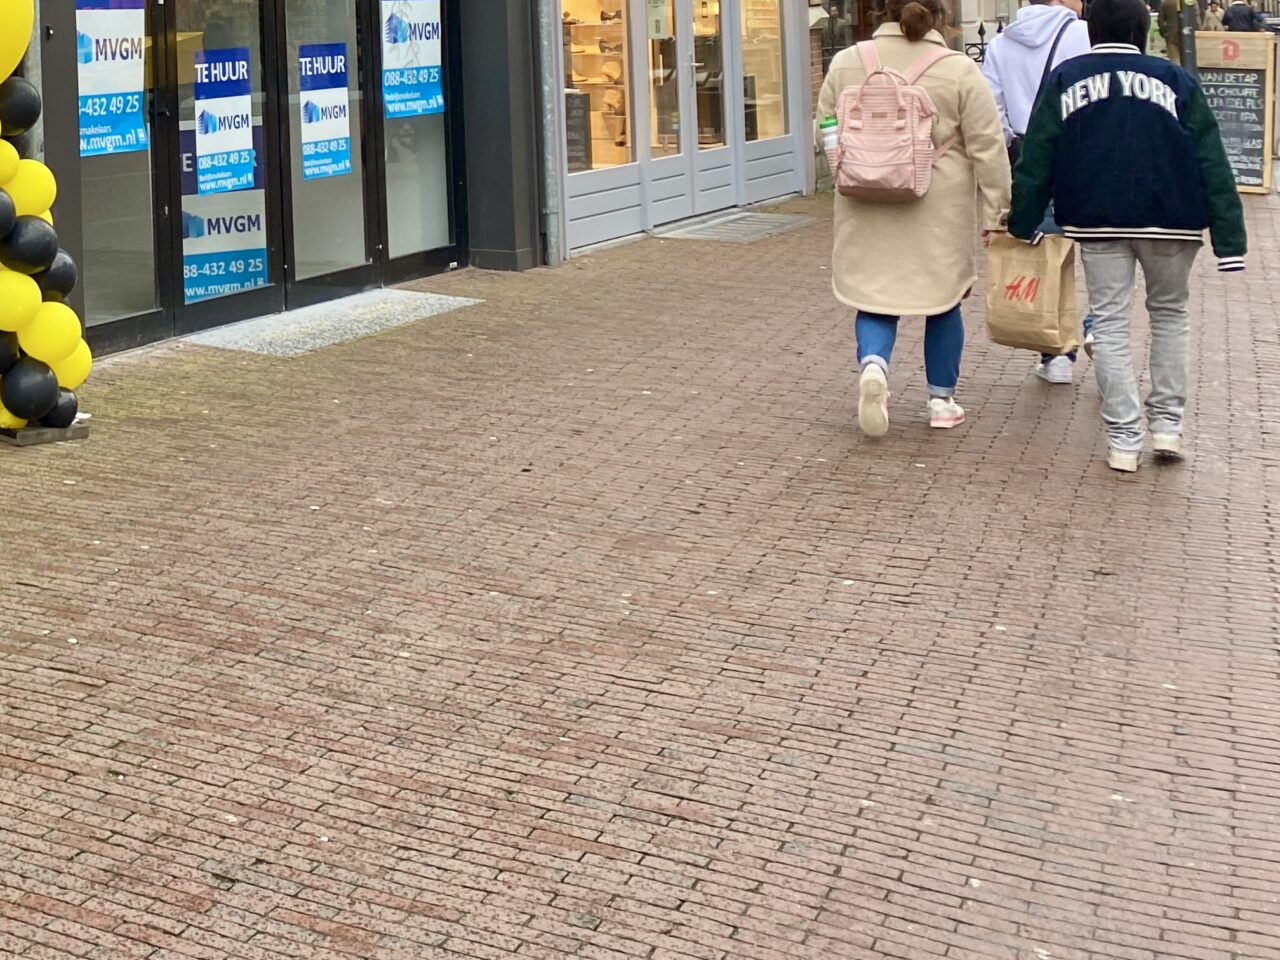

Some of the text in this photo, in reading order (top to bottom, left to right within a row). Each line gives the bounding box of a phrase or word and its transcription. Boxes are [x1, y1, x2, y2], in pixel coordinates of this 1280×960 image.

[409, 22, 440, 41] MVGM
[95, 38, 142, 61] MVGM
[194, 60, 248, 83] TE HUUR
[299, 55, 346, 76] TE HUUR
[418, 69, 428, 83] 49
[429, 68, 439, 82] 25
[109, 96, 124, 114] 49
[125, 95, 140, 113] 25
[1061, 70, 1179, 121] NEW YORK
[218, 113, 250, 131] MVGM
[321, 104, 347, 121] MVGM
[229, 152, 239, 165] 49
[240, 151, 250, 163] 25
[207, 214, 261, 236] MVGM
[229, 260, 244, 274] 49
[248, 258, 263, 272] 25
